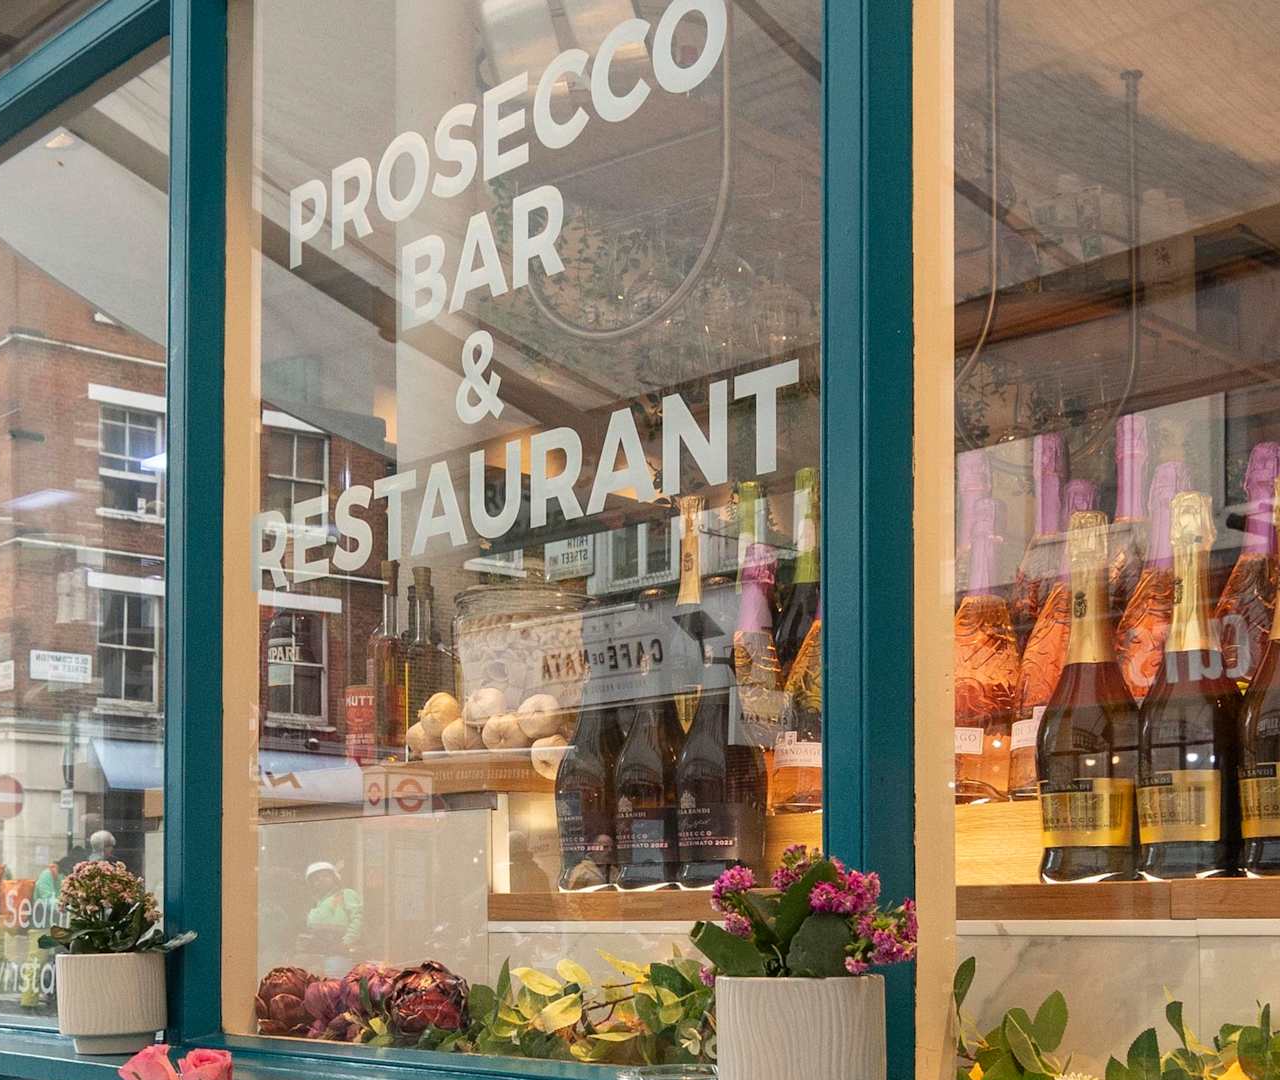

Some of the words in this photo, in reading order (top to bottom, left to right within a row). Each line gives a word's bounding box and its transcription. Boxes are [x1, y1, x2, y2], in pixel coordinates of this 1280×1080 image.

[289, 0, 726, 270] PROSECCO
[400, 185, 564, 332] BAR
[457, 330, 504, 424] &
[252, 359, 800, 592] RESTAURANT
[714, 839, 734, 847] 2022
